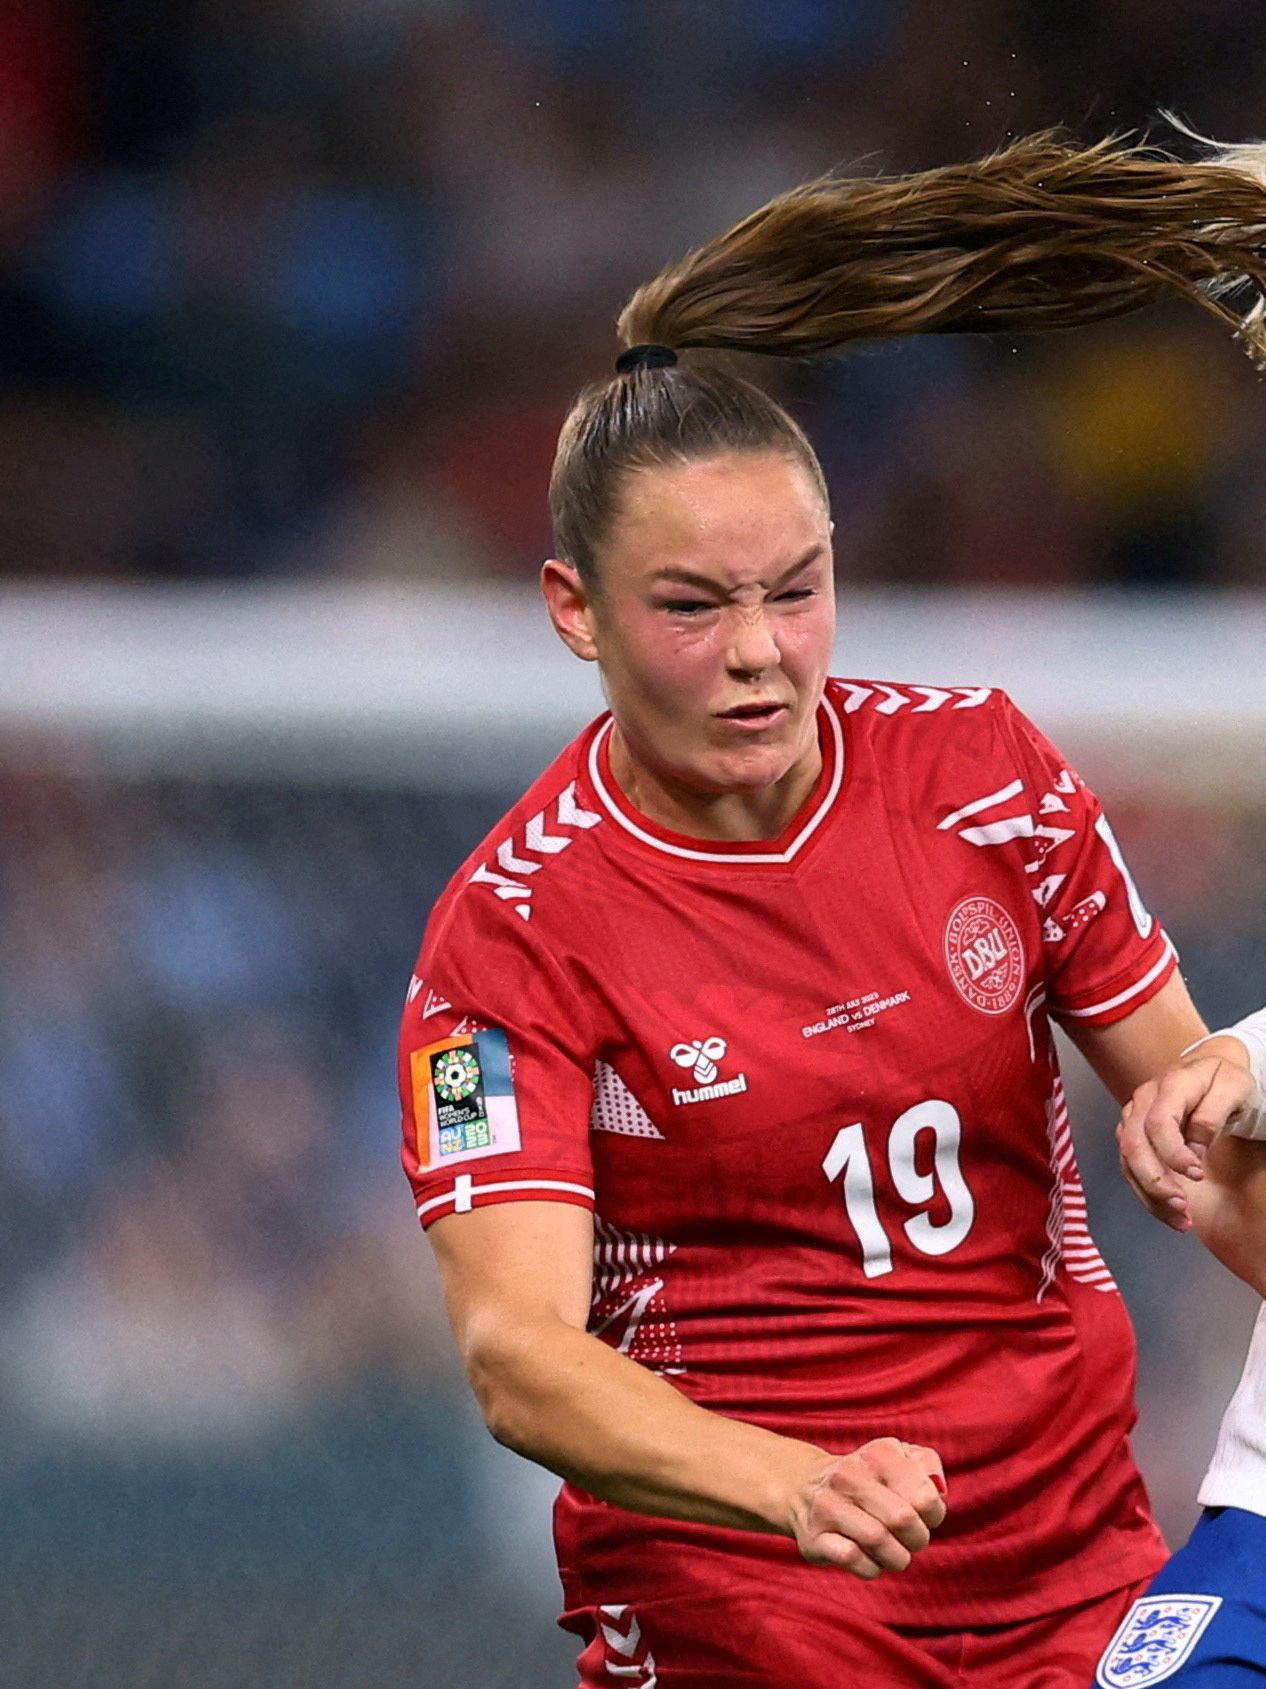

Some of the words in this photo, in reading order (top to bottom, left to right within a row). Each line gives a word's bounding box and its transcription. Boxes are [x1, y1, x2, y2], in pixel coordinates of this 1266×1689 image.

[962, 927, 1008, 980] DBU
[802, 1014, 850, 1038] ENGLAND
[863, 990, 911, 1016] DENMARK
[846, 1018, 875, 1033] SYDNEY
[672, 1073, 747, 1106] hummel
[438, 1104, 454, 1115] FIFA
[463, 1111, 477, 1121] CUP
[441, 1127, 461, 1143] AU
[822, 1099, 975, 1279] 19
